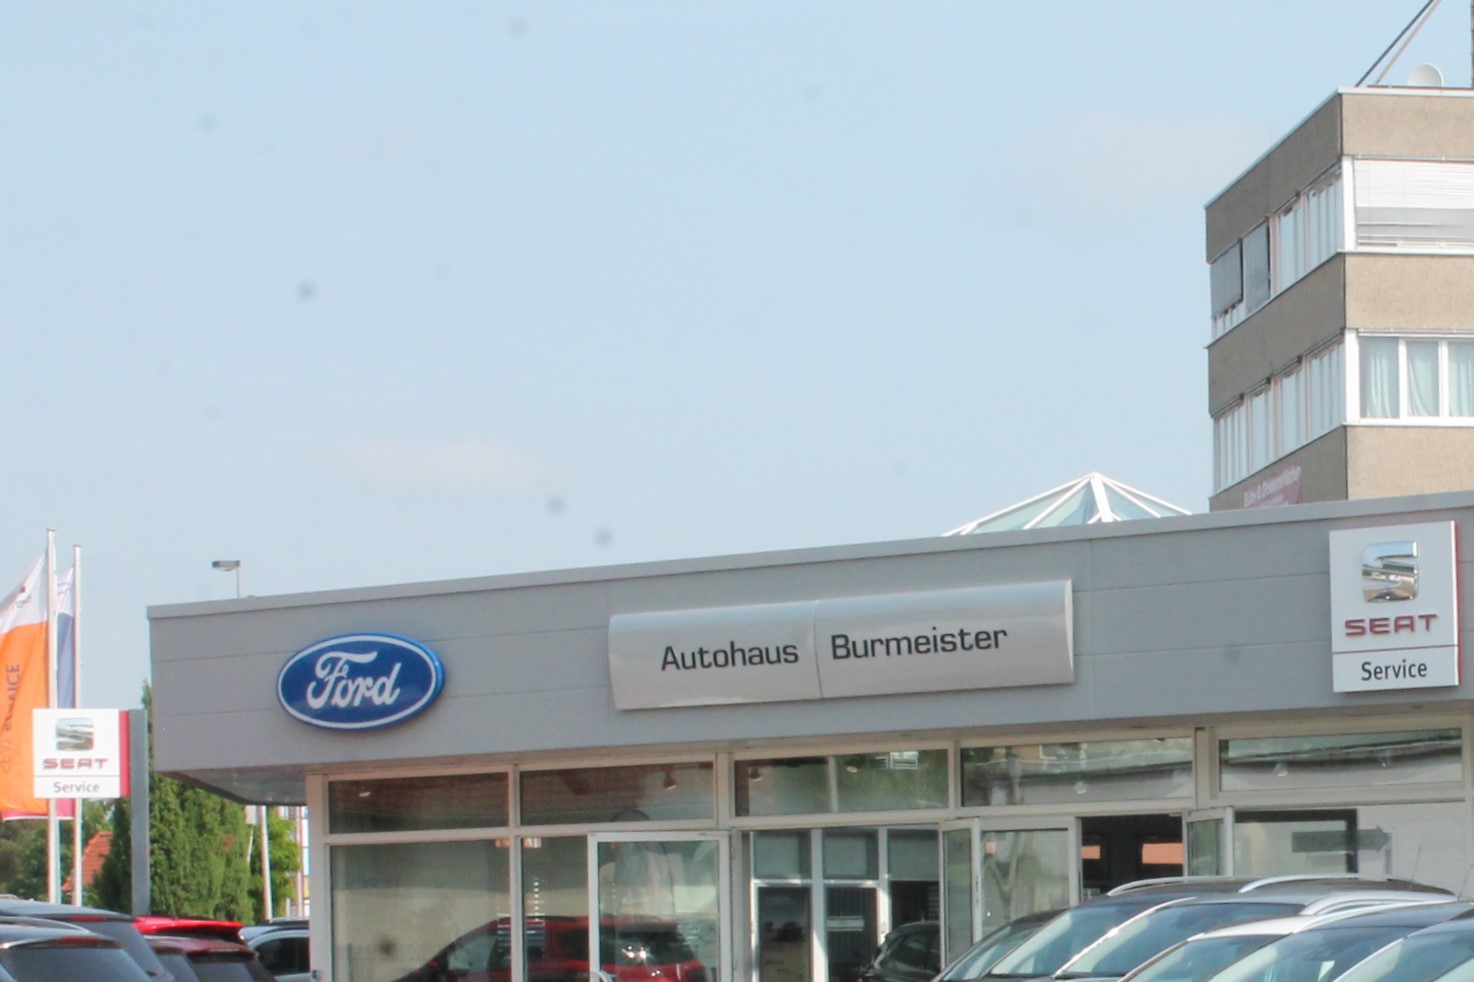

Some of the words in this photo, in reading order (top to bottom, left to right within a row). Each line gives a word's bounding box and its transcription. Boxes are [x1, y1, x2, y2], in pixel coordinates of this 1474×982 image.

[1344, 613, 1438, 637] SEAT
[660, 640, 800, 672] Autohaus
[831, 626, 1008, 660] Burmeister
[306, 651, 402, 709] Ford
[1361, 659, 1428, 681] Service
[43, 758, 108, 769] SEAT
[53, 781, 100, 793] Service
